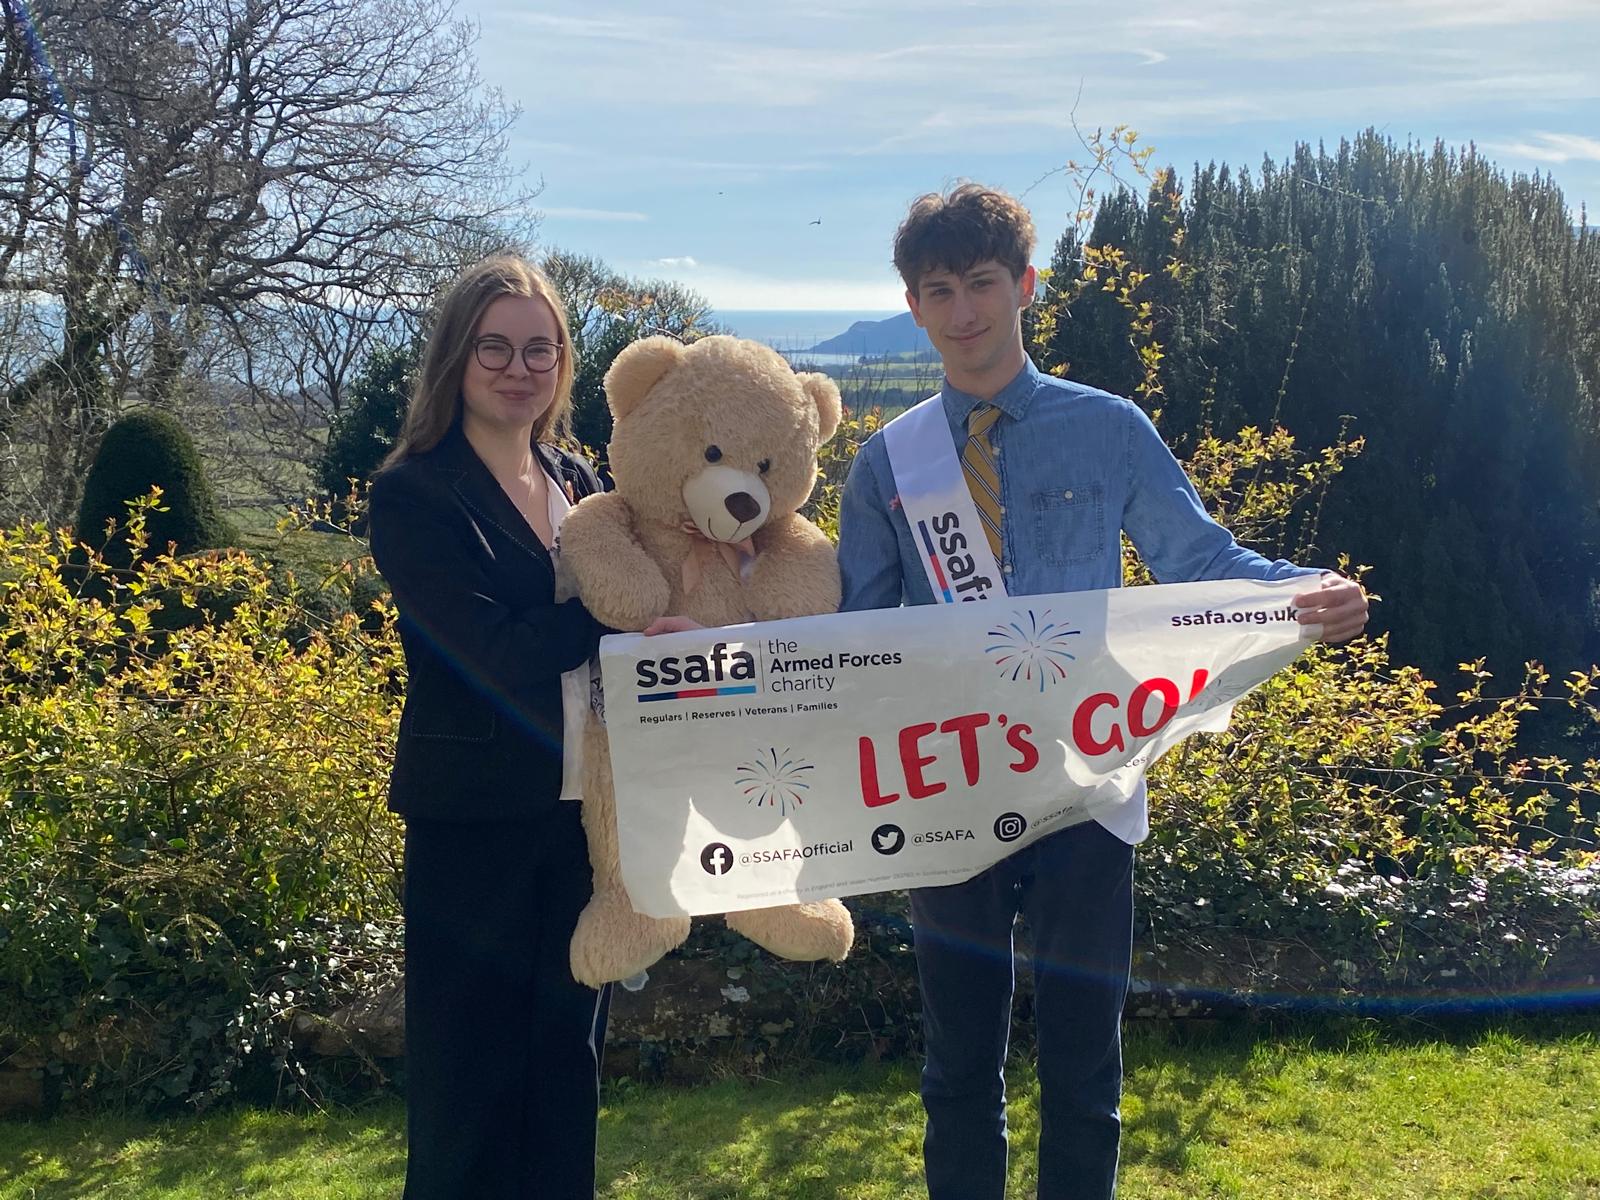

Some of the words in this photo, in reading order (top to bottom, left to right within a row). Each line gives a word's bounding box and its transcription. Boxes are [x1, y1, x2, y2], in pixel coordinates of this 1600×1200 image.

[932, 511, 993, 602] ssaf
[1171, 606, 1299, 627] ssafa.org.uk
[767, 638, 798, 655] the
[635, 642, 756, 688] ssafa
[769, 653, 834, 674] Armed
[838, 650, 902, 669] Forces
[771, 674, 836, 693] charity
[639, 711, 683, 724] Regulars
[691, 709, 736, 720] Reserves
[744, 705, 788, 716] Veterans
[797, 701, 838, 712] Families
[911, 829, 976, 845] @SSAFA
[738, 840, 853, 866] @SSAFAOfficial
